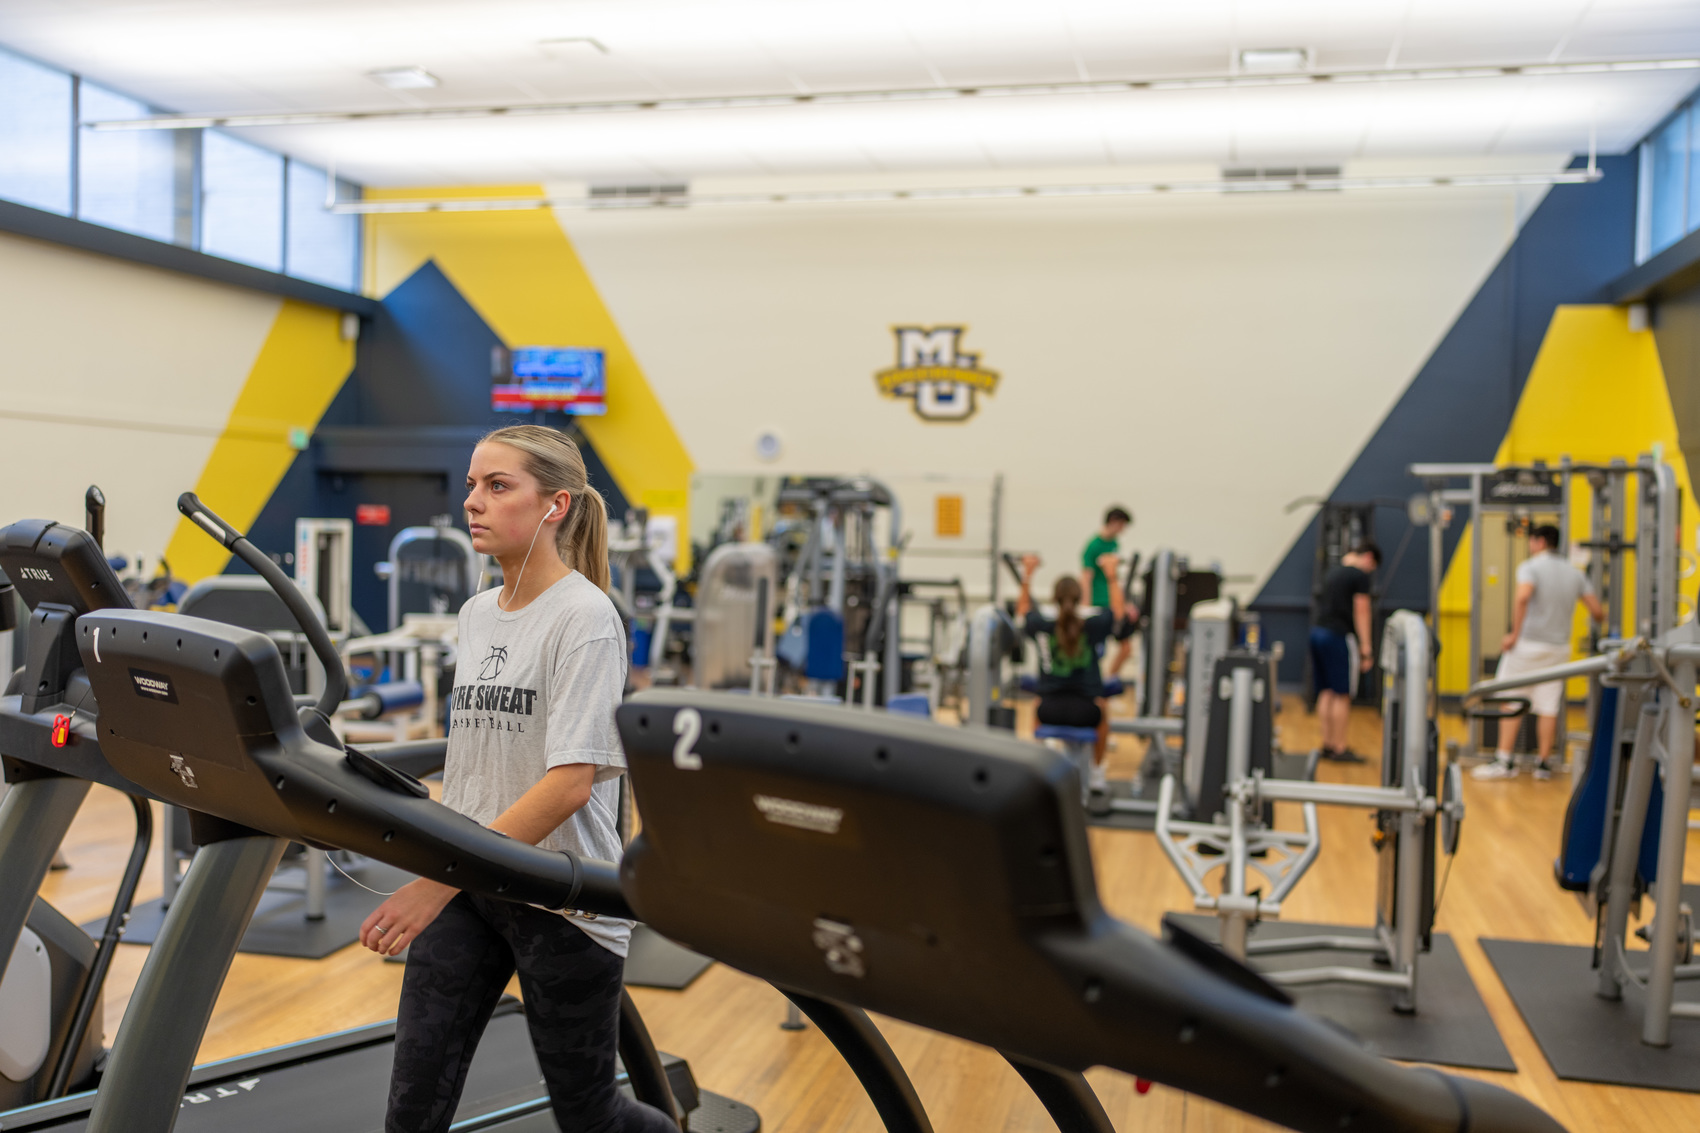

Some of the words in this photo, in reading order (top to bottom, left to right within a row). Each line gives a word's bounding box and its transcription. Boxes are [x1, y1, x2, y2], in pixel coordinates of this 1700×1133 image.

[23, 567, 53, 581] TRUE
[93, 626, 102, 663] 1
[451, 685, 475, 711] URE
[476, 685, 537, 715] SWEAT
[452, 717, 525, 733] ASKETBALL
[672, 708, 703, 770] 2
